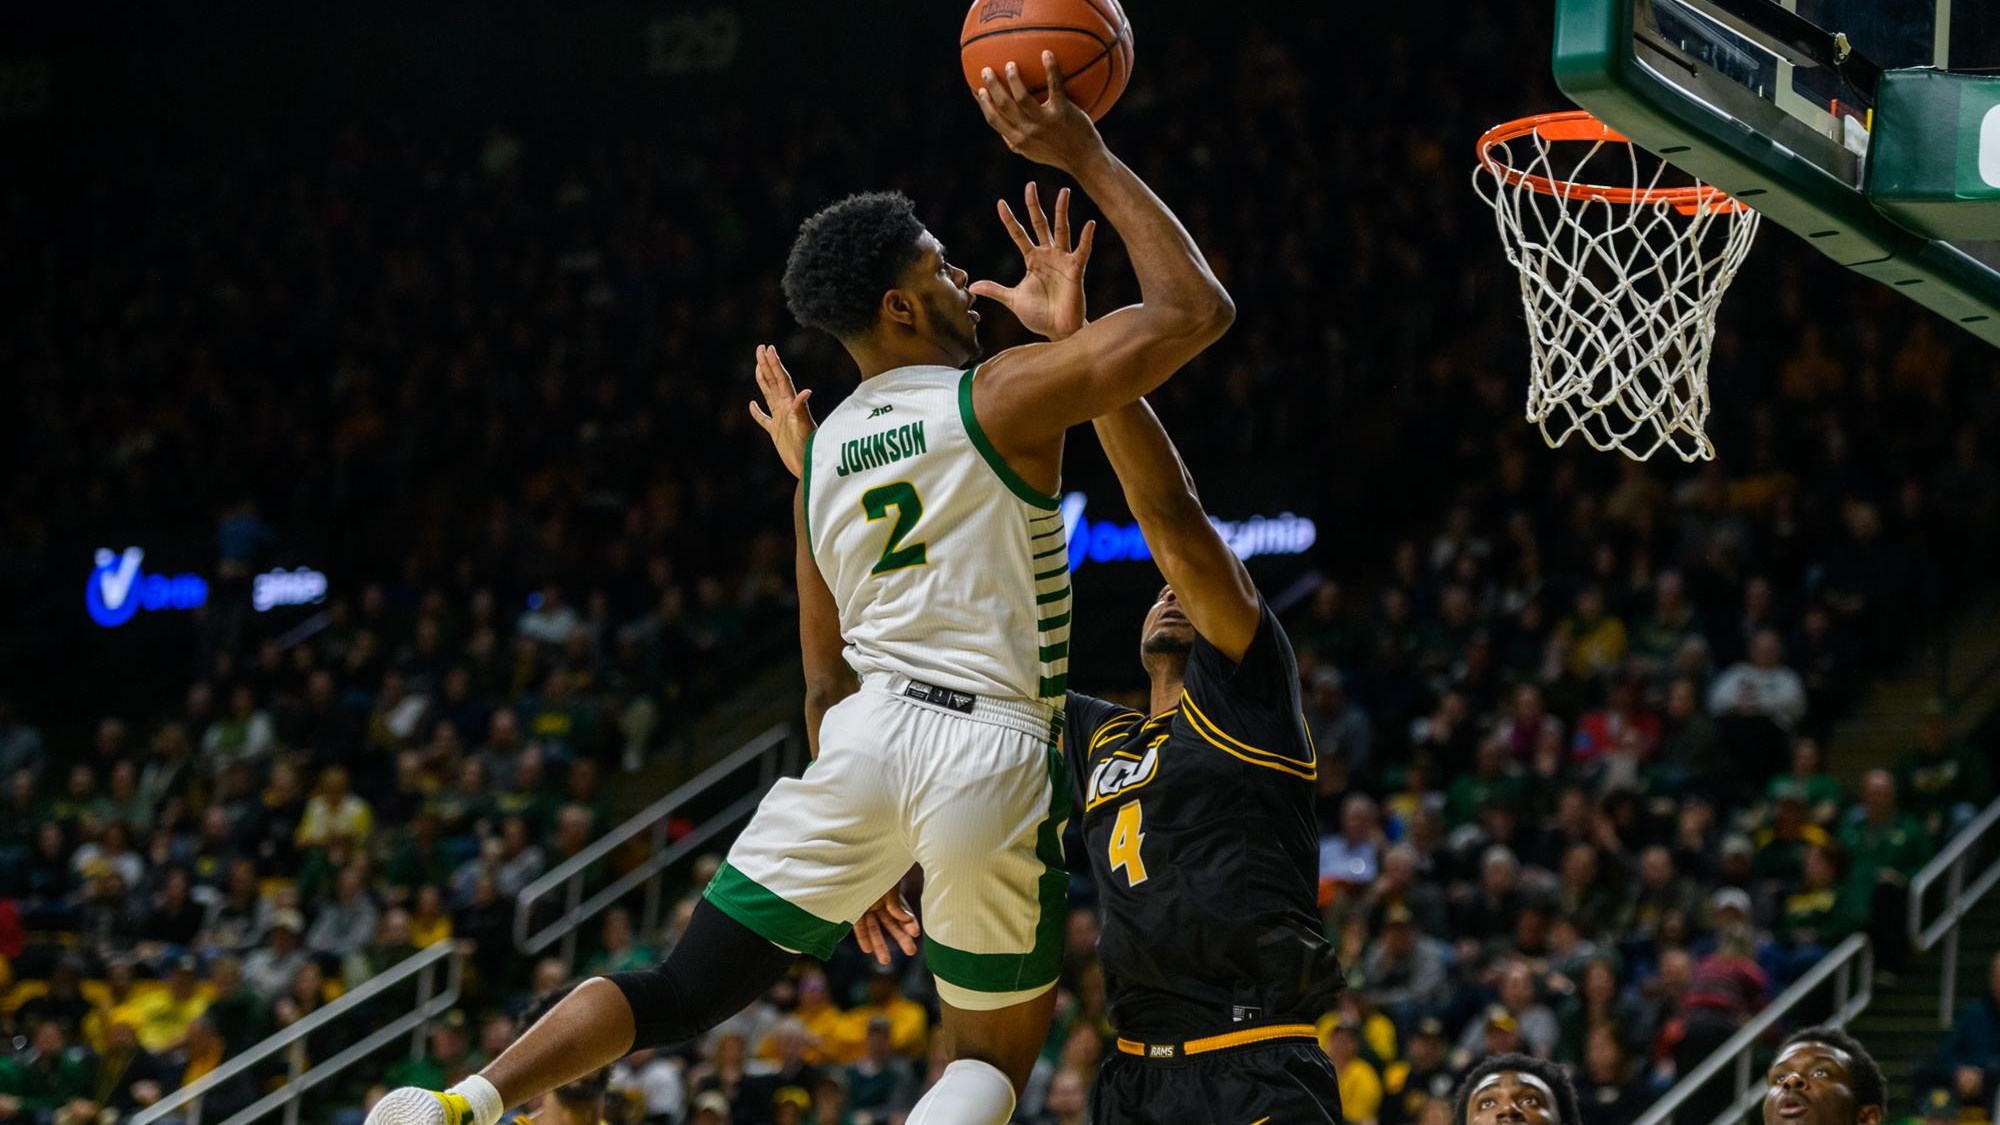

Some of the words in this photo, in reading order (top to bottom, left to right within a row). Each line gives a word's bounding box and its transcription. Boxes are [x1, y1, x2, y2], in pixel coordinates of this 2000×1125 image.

[836, 420, 927, 477] JOHNSON
[862, 479, 928, 577] 2
[1108, 799, 1149, 888] 4
[1151, 1046, 1174, 1056] RAMS
